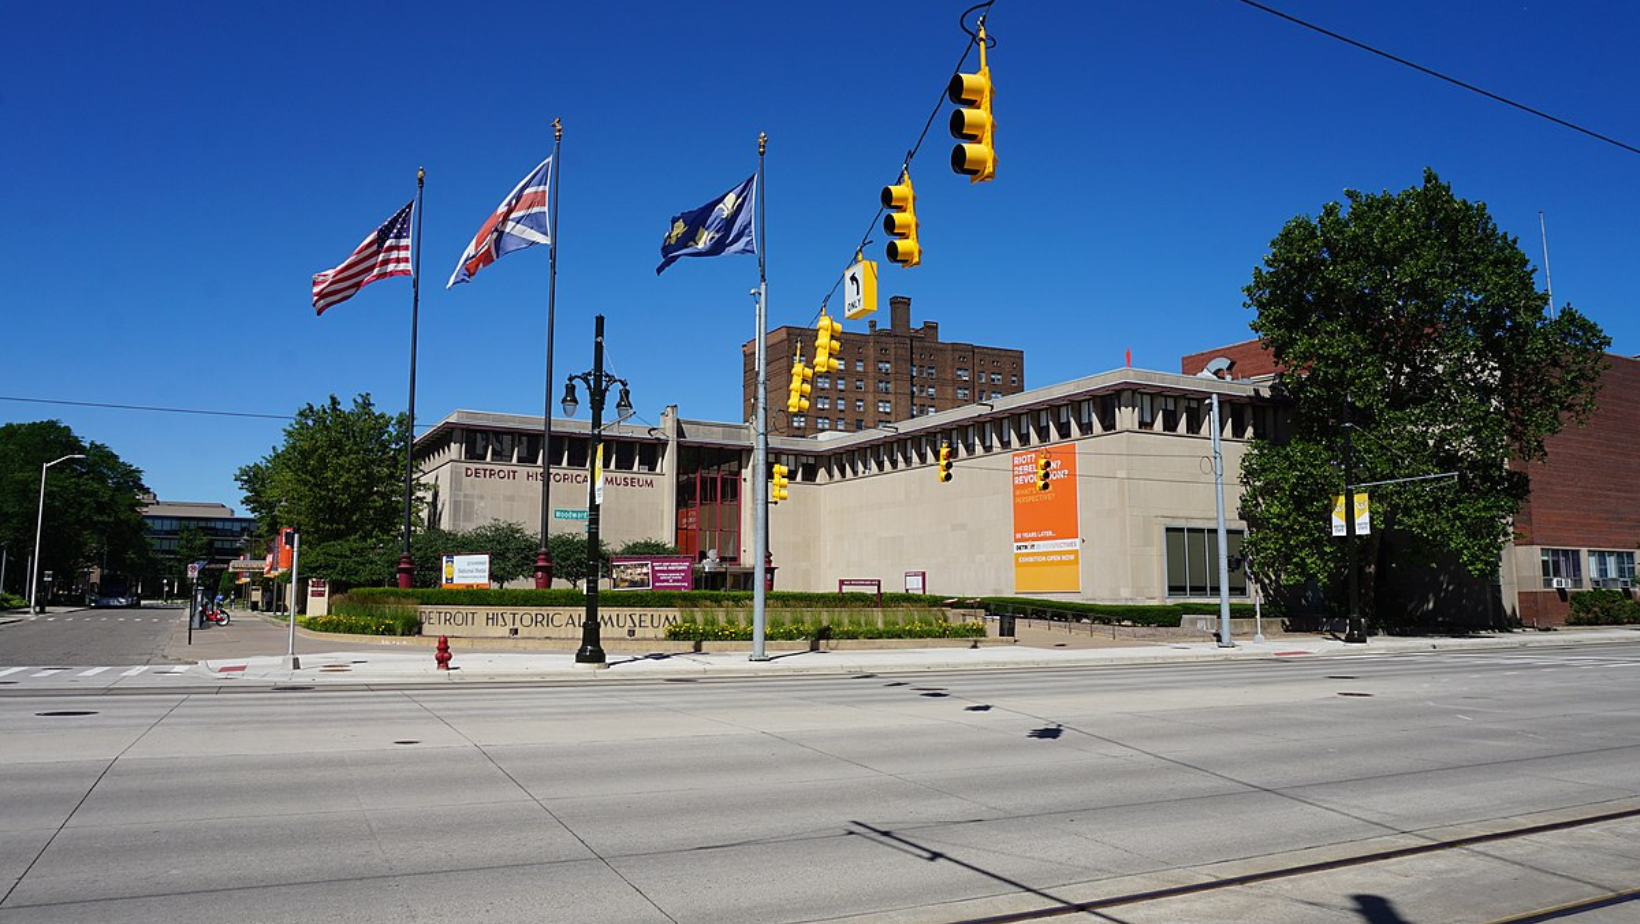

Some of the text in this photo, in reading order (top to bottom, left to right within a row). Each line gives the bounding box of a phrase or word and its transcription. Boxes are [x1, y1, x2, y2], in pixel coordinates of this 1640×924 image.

[847, 298, 861, 312] ONLY
[1013, 454, 1036, 465] RIOT?
[465, 467, 654, 488] DETROIT HISTORICA MUSEUM
[555, 511, 587, 519] Woodward
[419, 611, 679, 628] DETROIT HISTORICAL MUSEUM
